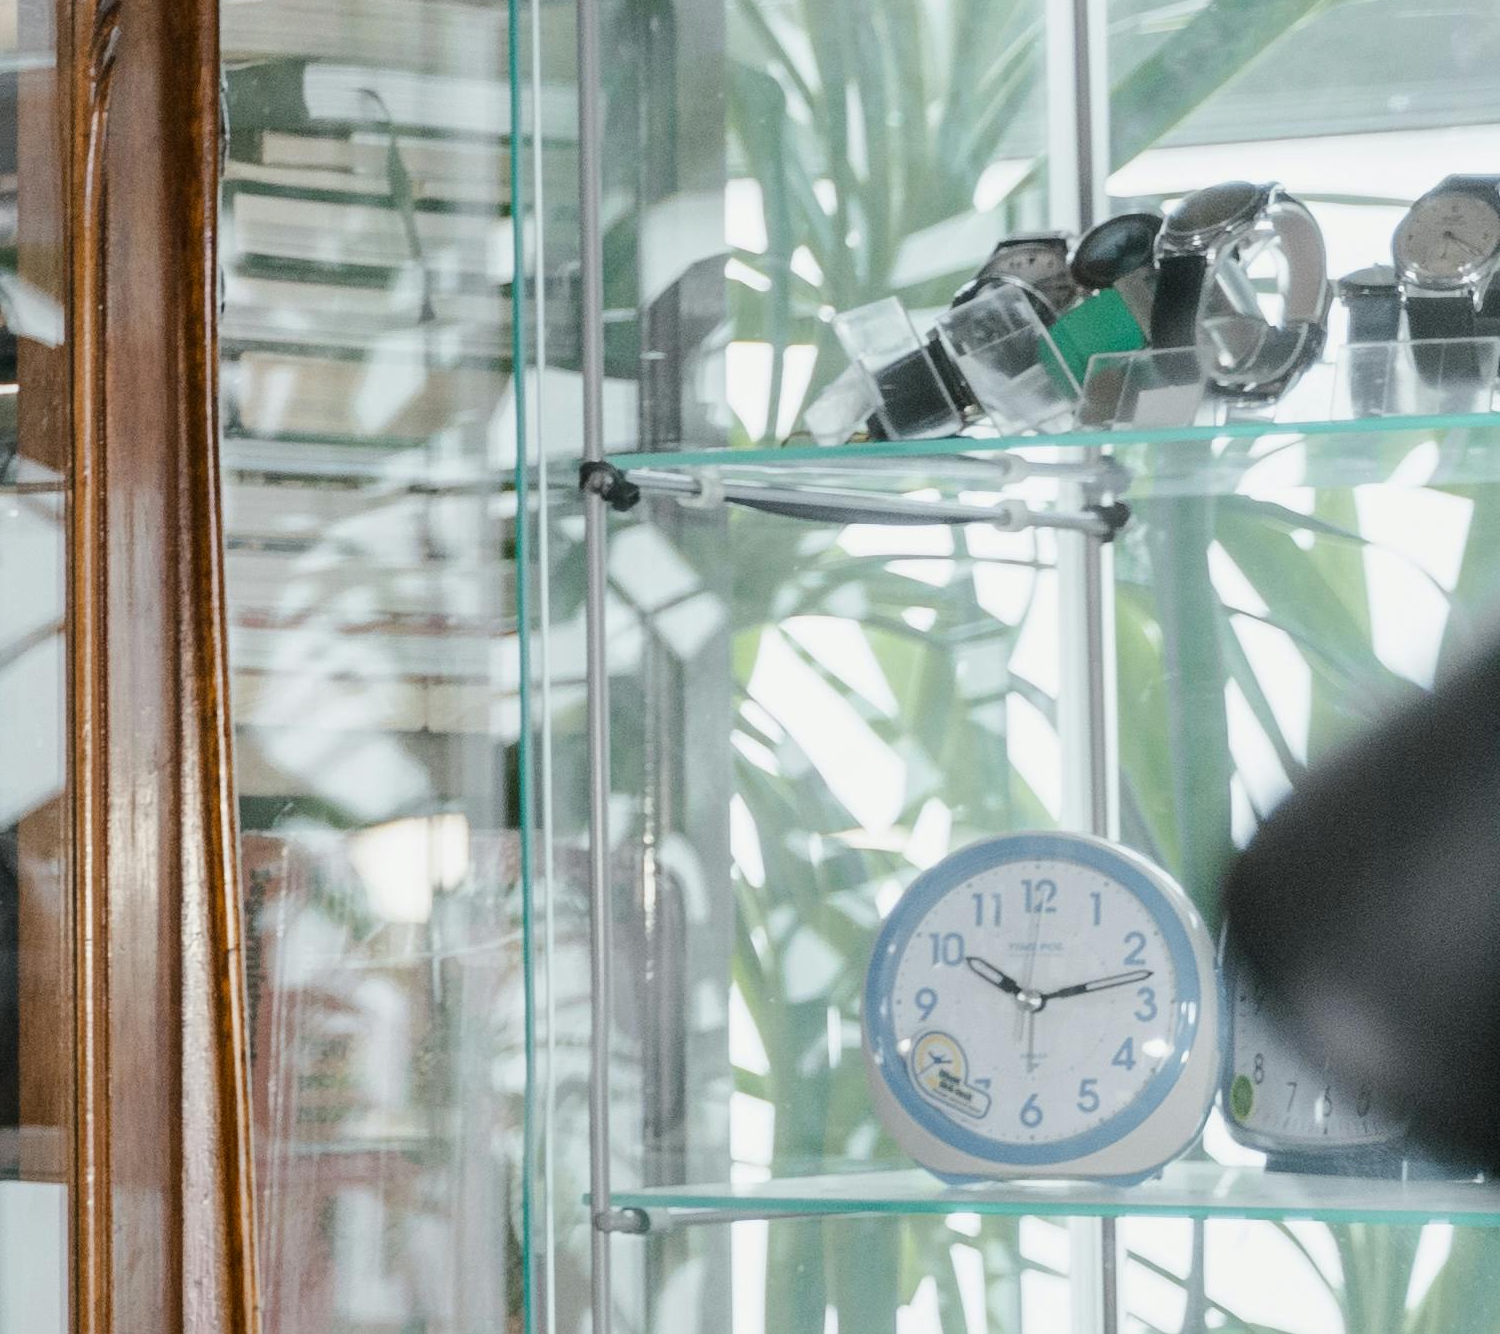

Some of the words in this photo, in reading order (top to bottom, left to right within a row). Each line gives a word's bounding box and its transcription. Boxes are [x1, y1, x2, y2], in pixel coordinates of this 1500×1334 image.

[971, 893, 1003, 927] 11
[1021, 878, 1058, 915] 12
[1090, 890, 1101, 926] 1
[929, 932, 966, 967] 10
[1123, 930, 1147, 966] 2
[915, 986, 939, 1022] 9
[1134, 986, 1159, 1023] 3
[1111, 1036, 1136, 1071] 4
[1020, 1093, 1044, 1129] 6
[1076, 1078, 1101, 1113] 5
